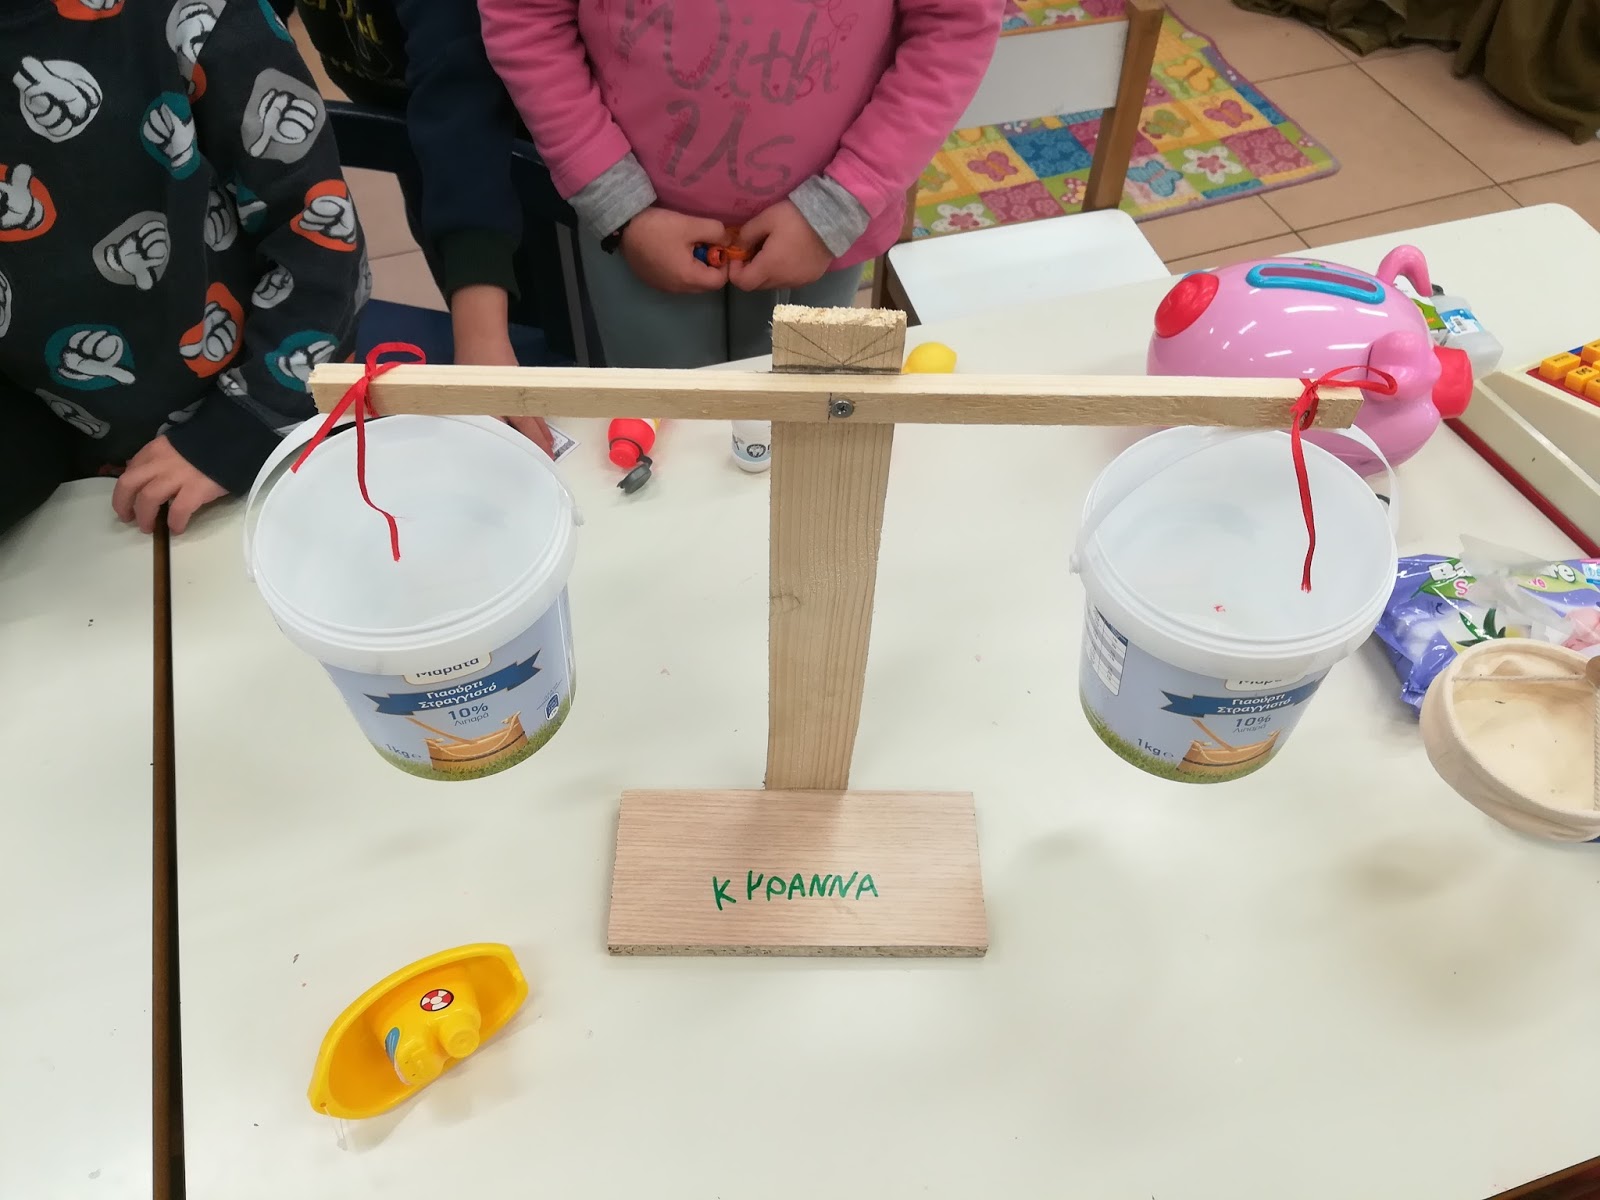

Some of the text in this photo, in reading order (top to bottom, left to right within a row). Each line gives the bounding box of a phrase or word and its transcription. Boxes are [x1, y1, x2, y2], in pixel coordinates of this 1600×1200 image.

[418, 682, 497, 709] Στραγγιστό
[426, 680, 484, 699] Γιαούρτι
[1217, 696, 1292, 714] Στραγγιστό
[1232, 693, 1286, 705] Γιαούρτι
[448, 702, 489, 720] 10%
[1235, 714, 1271, 728] 10%
